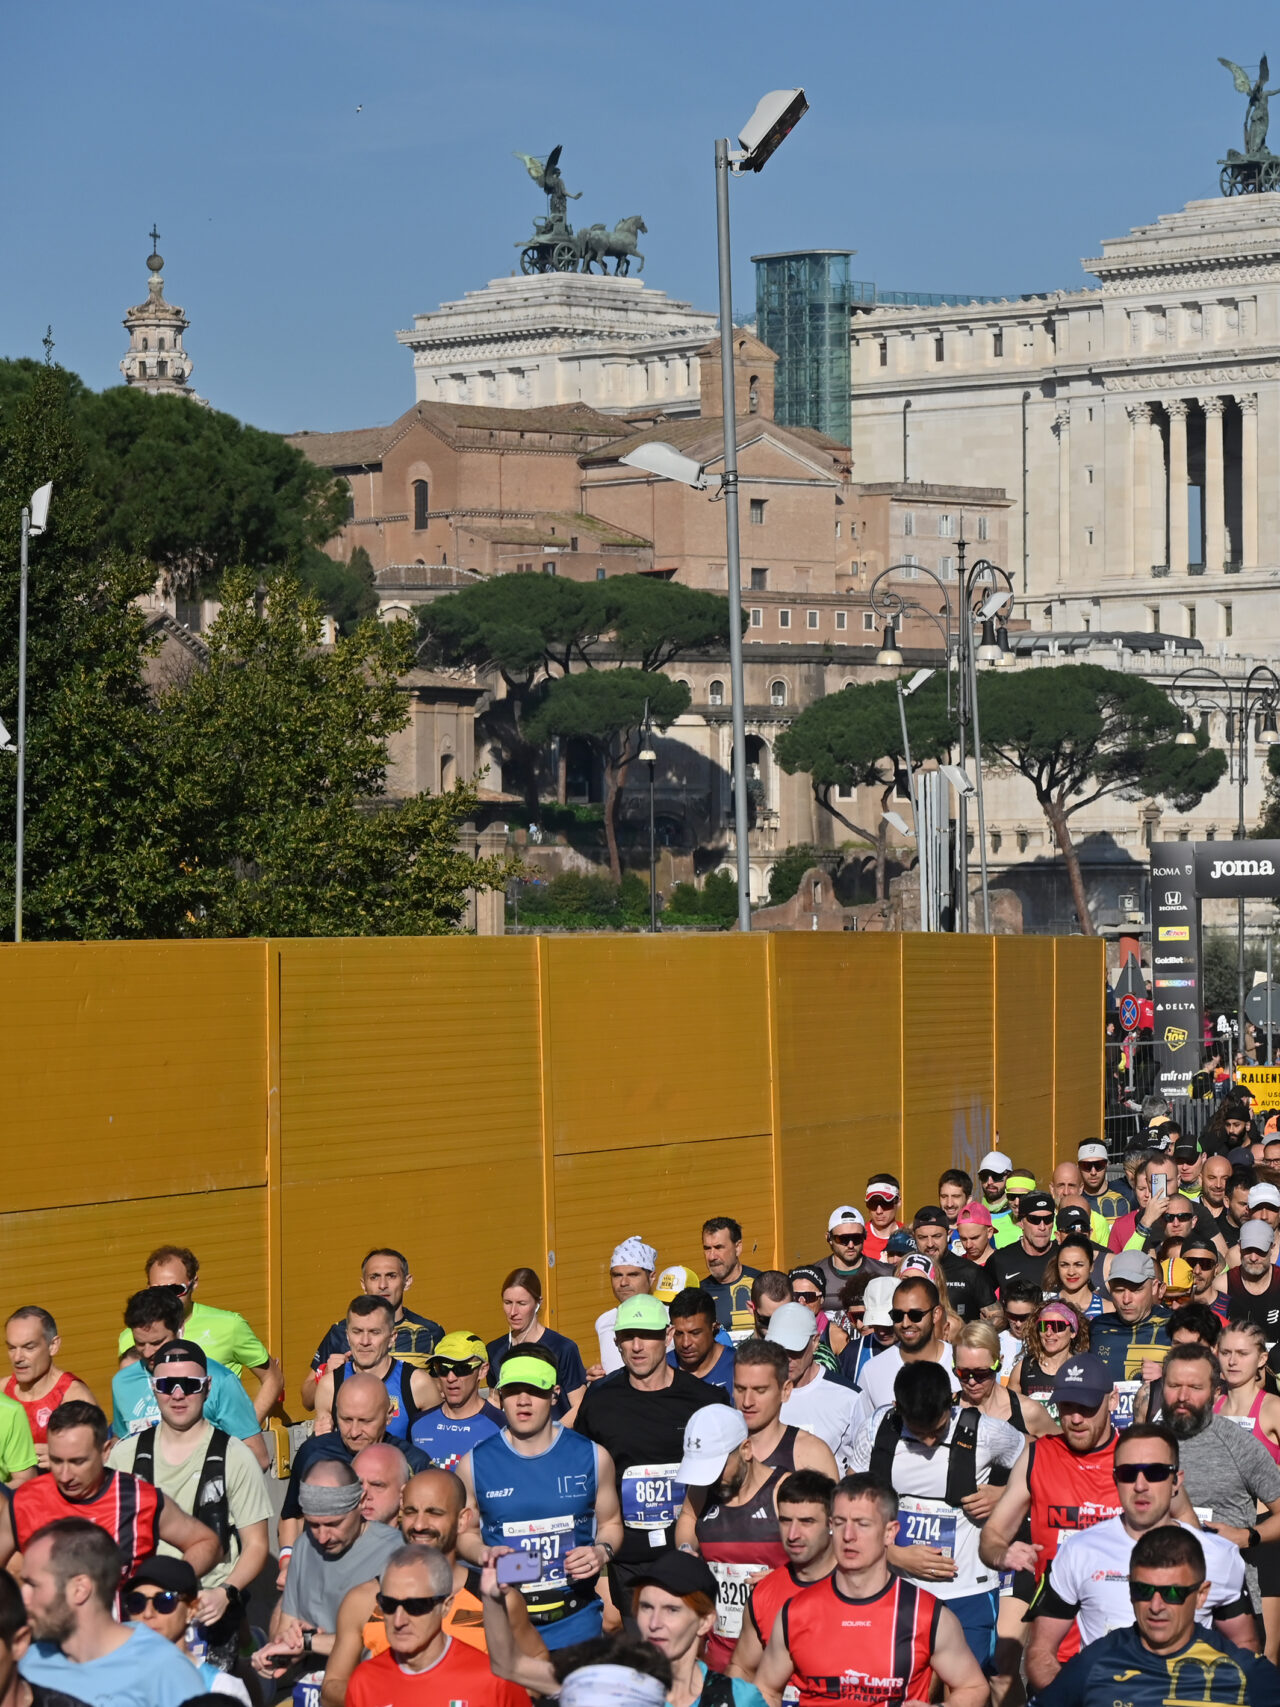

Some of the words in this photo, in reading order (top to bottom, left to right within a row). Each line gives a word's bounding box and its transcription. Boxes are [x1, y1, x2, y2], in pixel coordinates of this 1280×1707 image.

[1153, 867, 1181, 876] ROMA
[1210, 859, 1275, 878] joma
[436, 1423, 471, 1432] GIVOVA
[486, 1487, 514, 1499] CORE37
[635, 1480, 672, 1503] 8621
[660, 1510, 669, 1520] C
[1079, 1506, 1096, 1515] NO
[906, 1515, 941, 1540] 2714
[549, 1568, 559, 1579] C
[840, 1676, 860, 1685] NO
[864, 1677, 904, 1687] LIMITS
